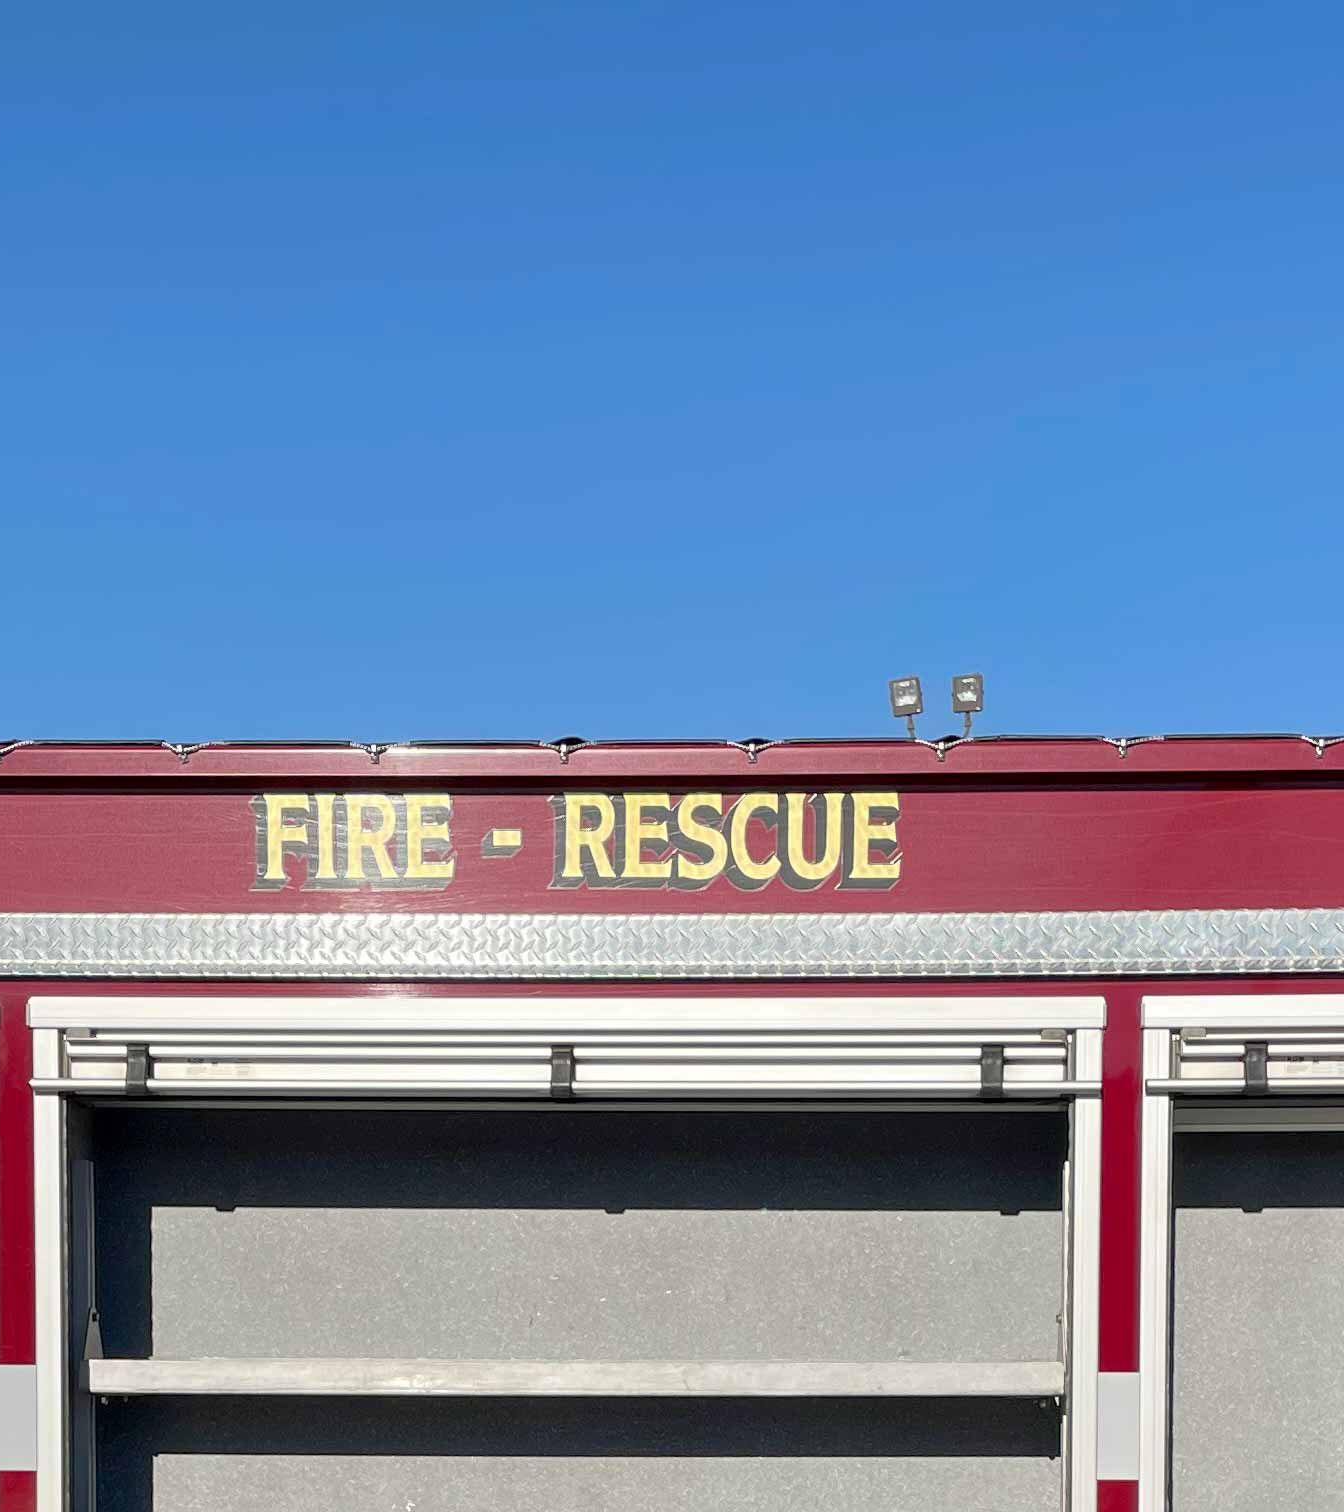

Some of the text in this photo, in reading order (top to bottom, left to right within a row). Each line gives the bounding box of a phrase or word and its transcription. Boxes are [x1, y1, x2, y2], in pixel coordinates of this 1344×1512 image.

[250, 790, 902, 890] FIRE - RESCUE
